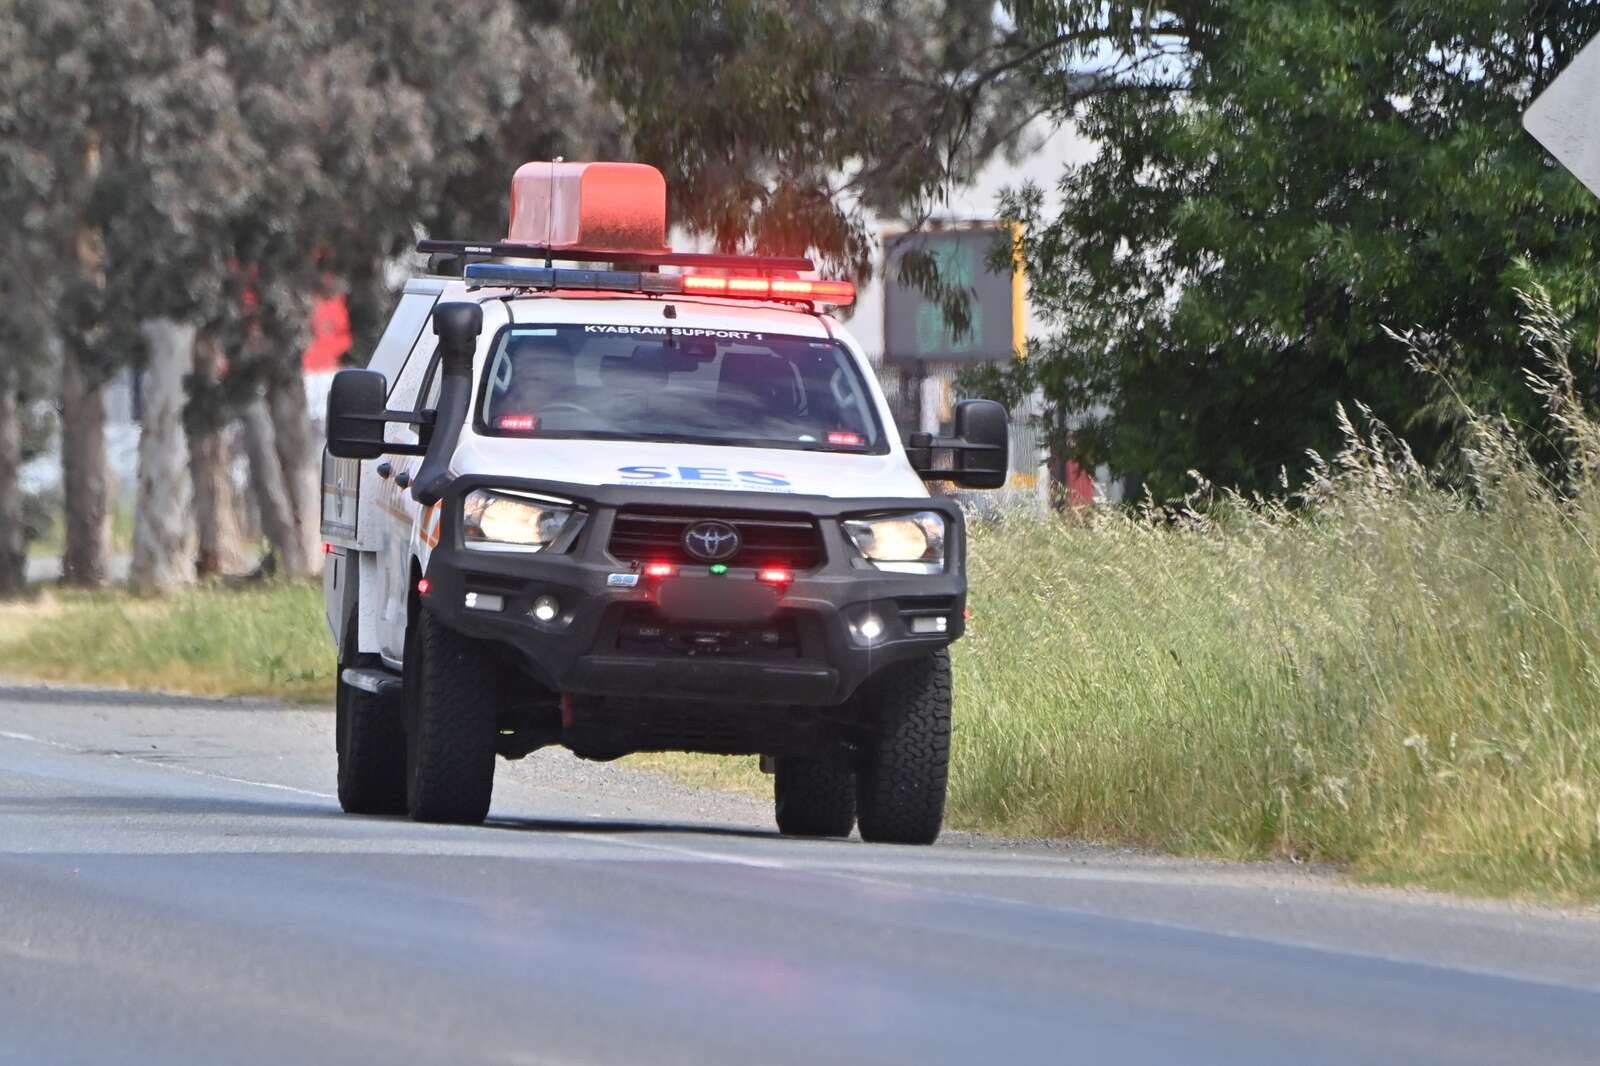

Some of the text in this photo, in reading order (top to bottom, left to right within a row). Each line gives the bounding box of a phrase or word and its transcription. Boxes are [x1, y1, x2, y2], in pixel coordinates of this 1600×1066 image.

[584, 325, 763, 341] KYABRAM SUPPORT 1
[617, 466, 791, 487] SES
